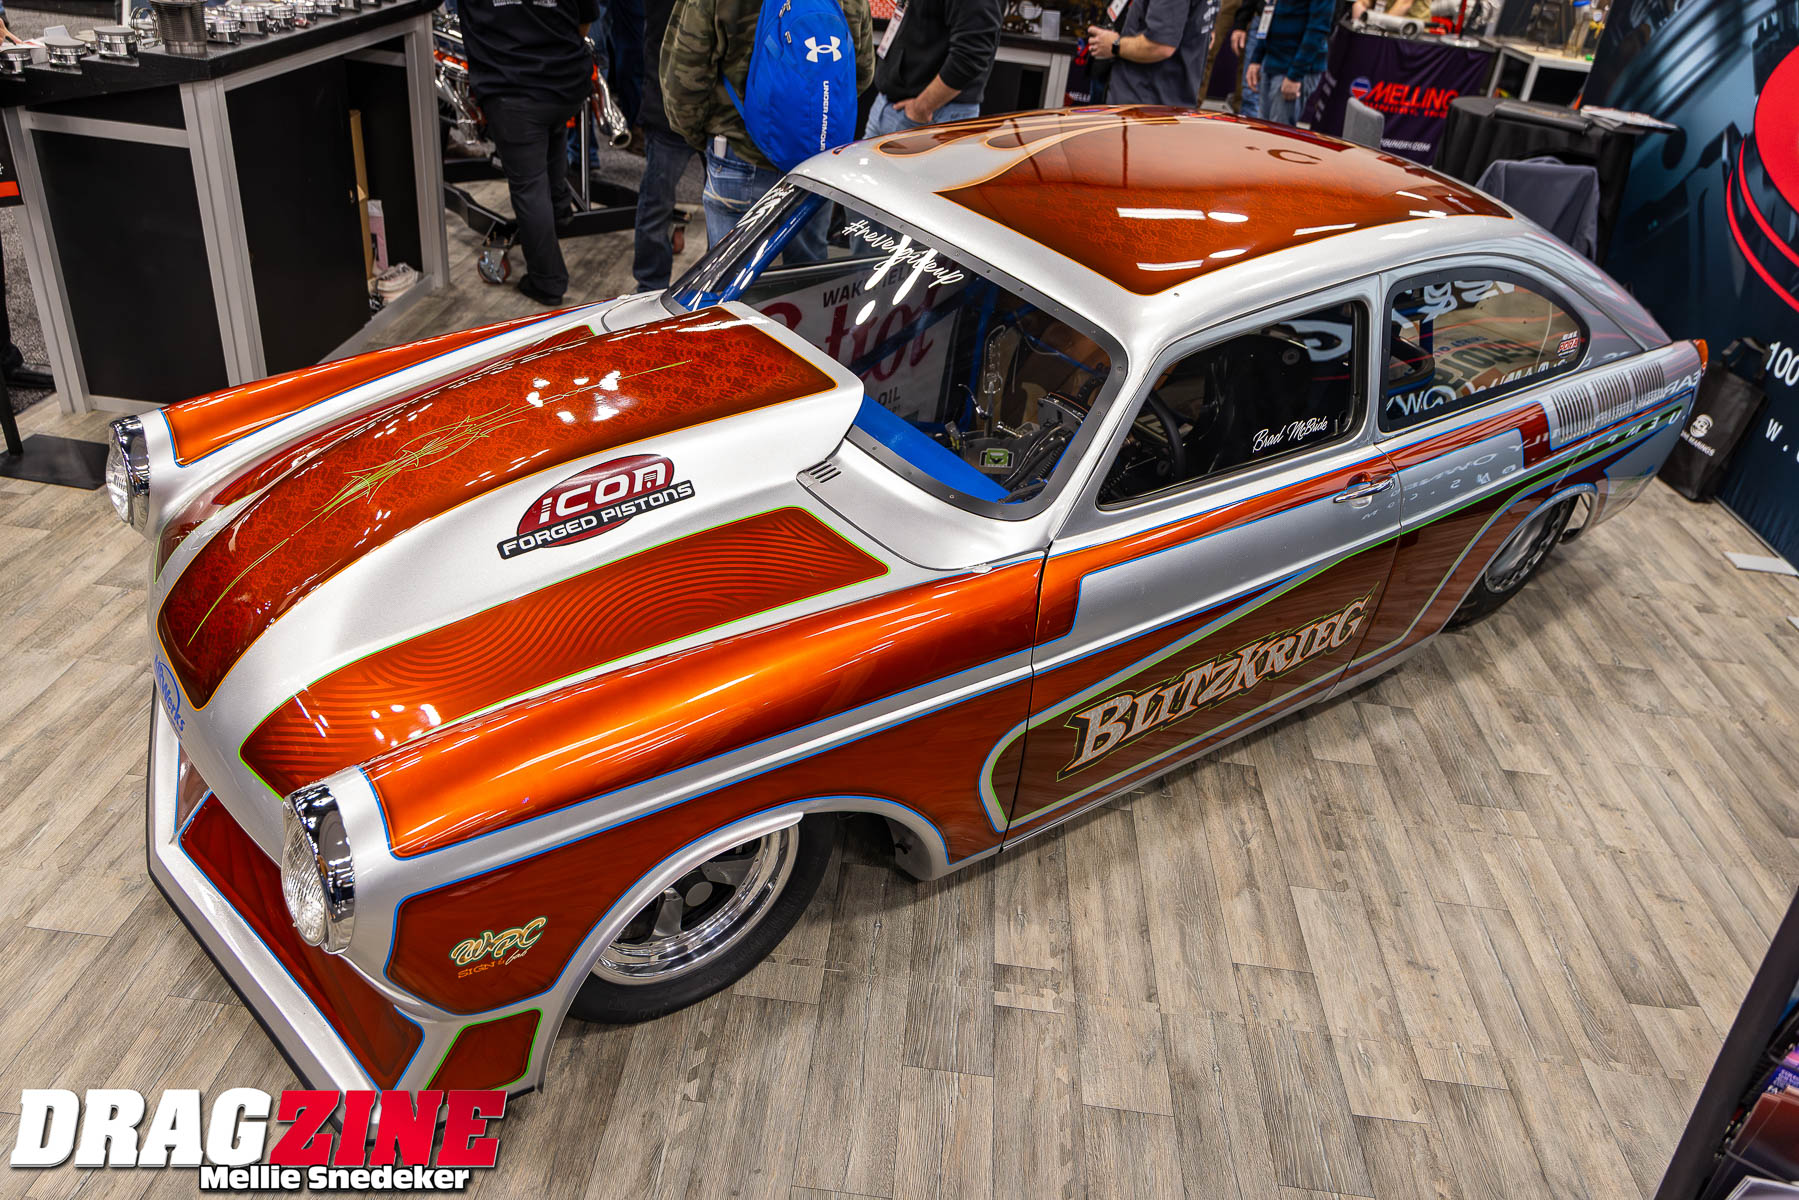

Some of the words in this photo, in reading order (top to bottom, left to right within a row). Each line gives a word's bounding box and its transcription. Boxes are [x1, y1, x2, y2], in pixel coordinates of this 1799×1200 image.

[822, 80, 830, 113] UNDER
[819, 113, 829, 152] ARMOUR
[1252, 424, 1287, 454] Brad
[1286, 415, 1328, 442] McBride
[501, 514, 598, 556] FORGED
[600, 482, 694, 523] PISTONS
[1065, 592, 1372, 772] BLITZKRIEG
